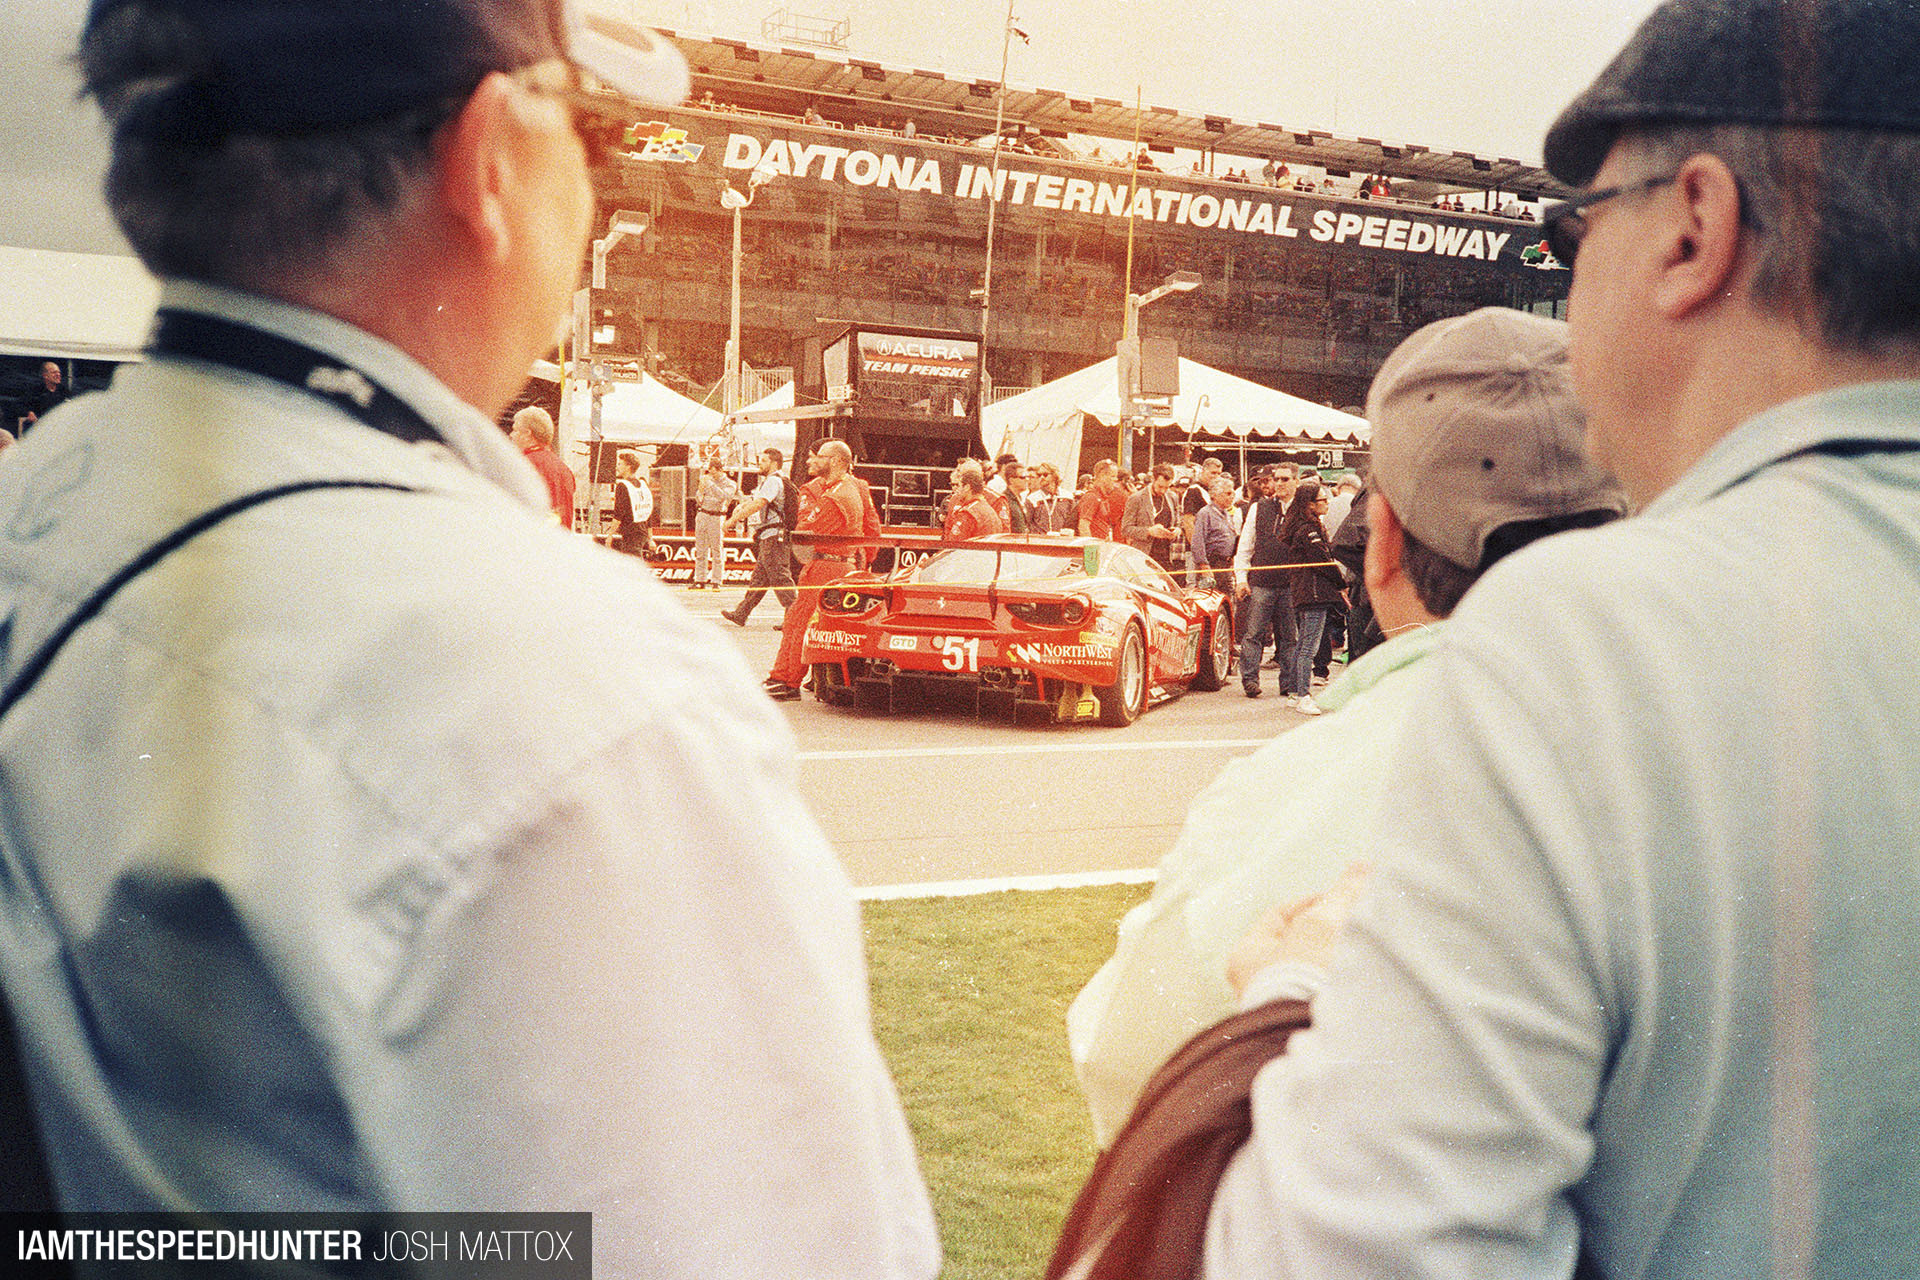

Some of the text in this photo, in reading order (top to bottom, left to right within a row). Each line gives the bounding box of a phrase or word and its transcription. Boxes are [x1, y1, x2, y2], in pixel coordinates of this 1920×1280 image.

[722, 133, 1511, 261] DAYTONA INTERNATIONAL SPEEDWAY
[892, 342, 963, 361] ACURA
[863, 360, 972, 378] TEAM PENSKE
[1316, 451, 1331, 468] 29
[891, 638, 915, 648] GTD
[941, 635, 980, 672] 51
